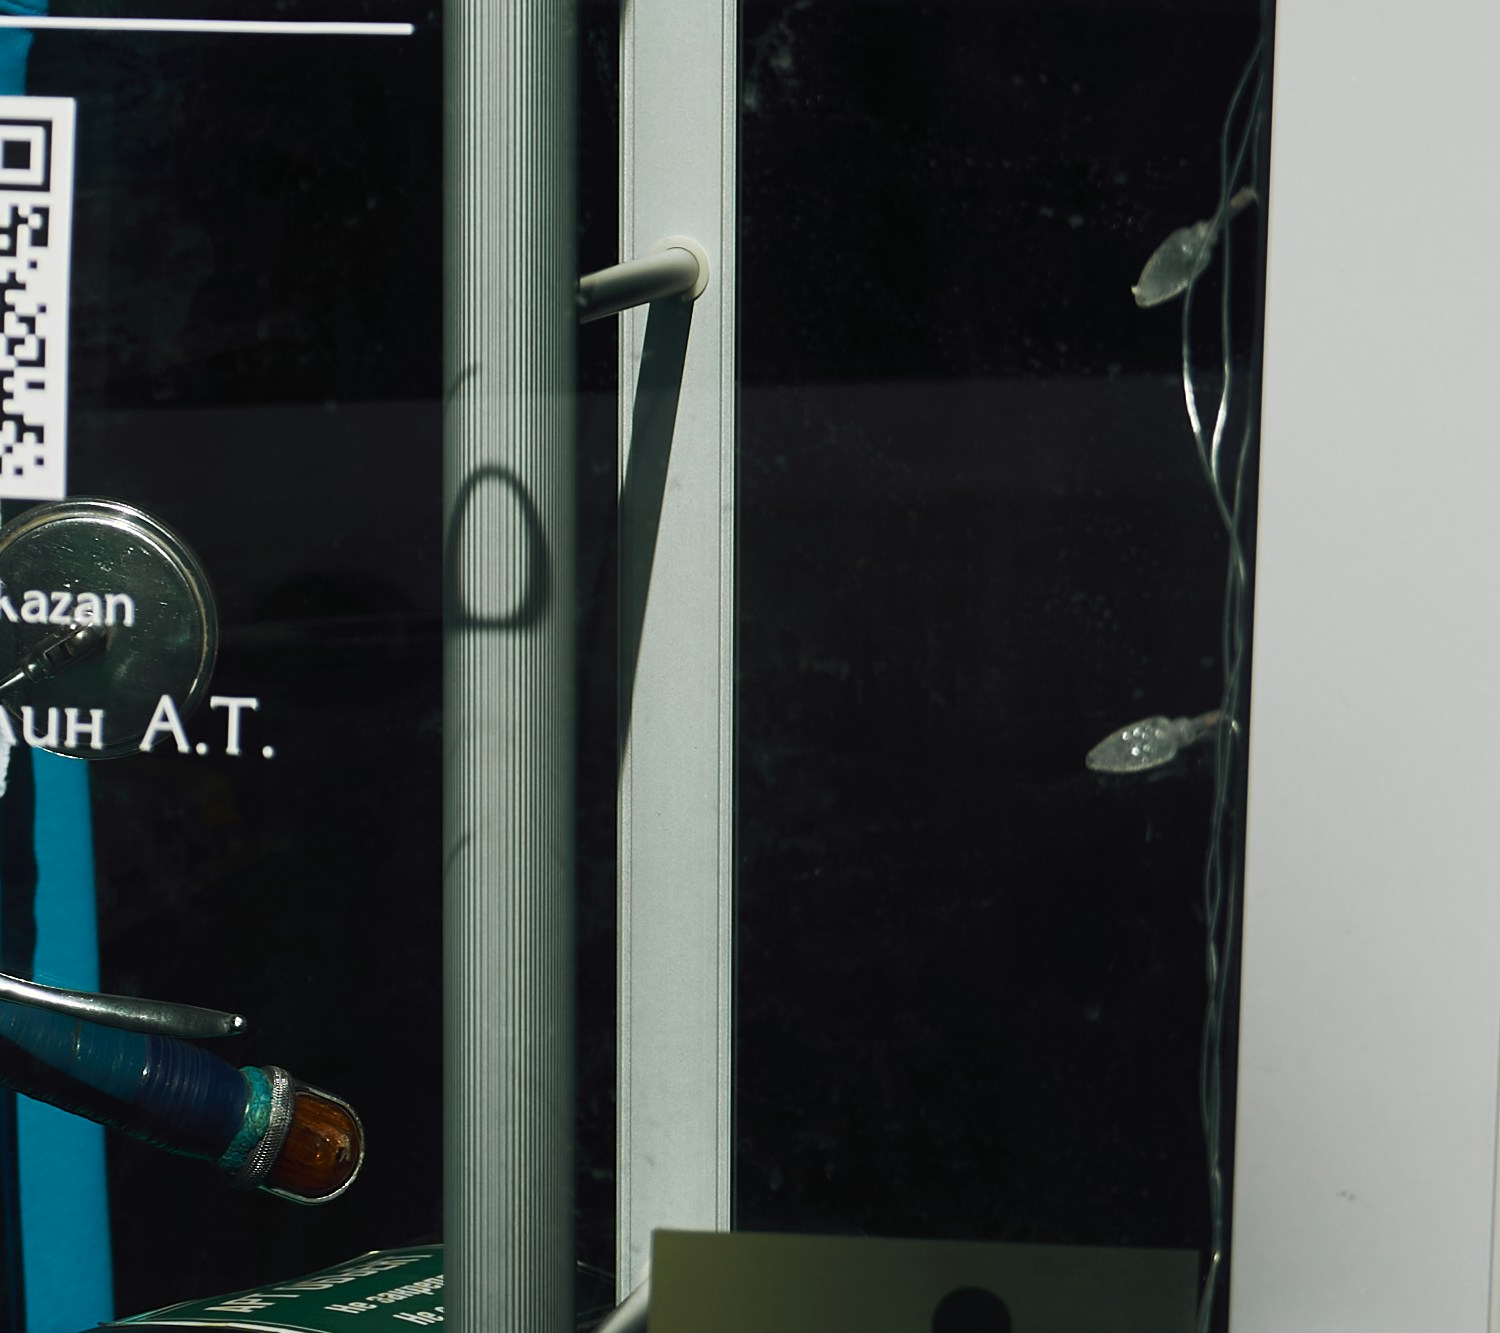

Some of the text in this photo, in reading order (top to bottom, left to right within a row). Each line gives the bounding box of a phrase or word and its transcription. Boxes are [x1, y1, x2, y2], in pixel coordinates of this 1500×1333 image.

[137, 694, 277, 760] А.Т.
[323, 1301, 378, 1314] Не
[392, 1311, 444, 1326] Не
